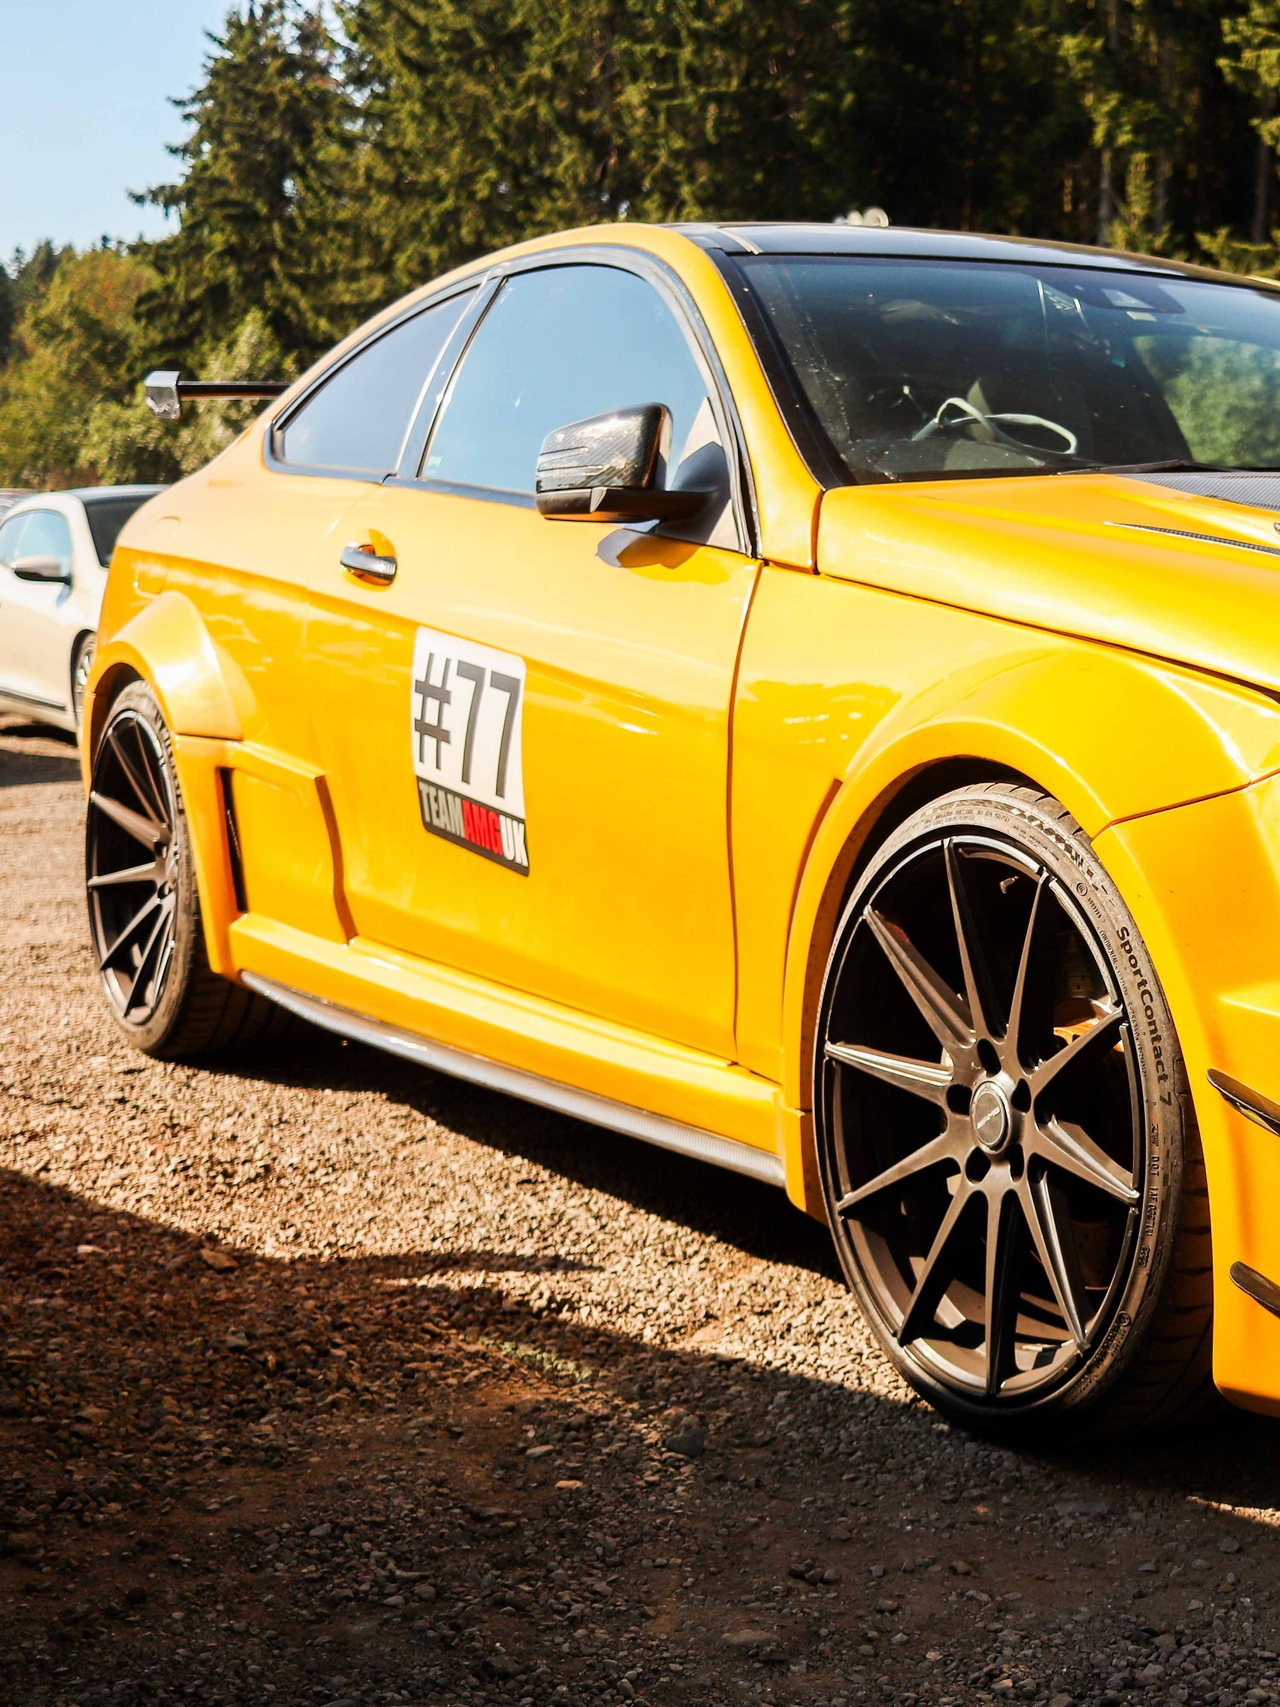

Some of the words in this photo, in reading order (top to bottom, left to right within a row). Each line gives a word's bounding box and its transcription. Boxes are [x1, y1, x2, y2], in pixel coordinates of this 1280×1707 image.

[414, 652, 521, 799] #77
[1117, 926, 1168, 1084] SportContact
[1160, 1091, 1172, 1106] 7
